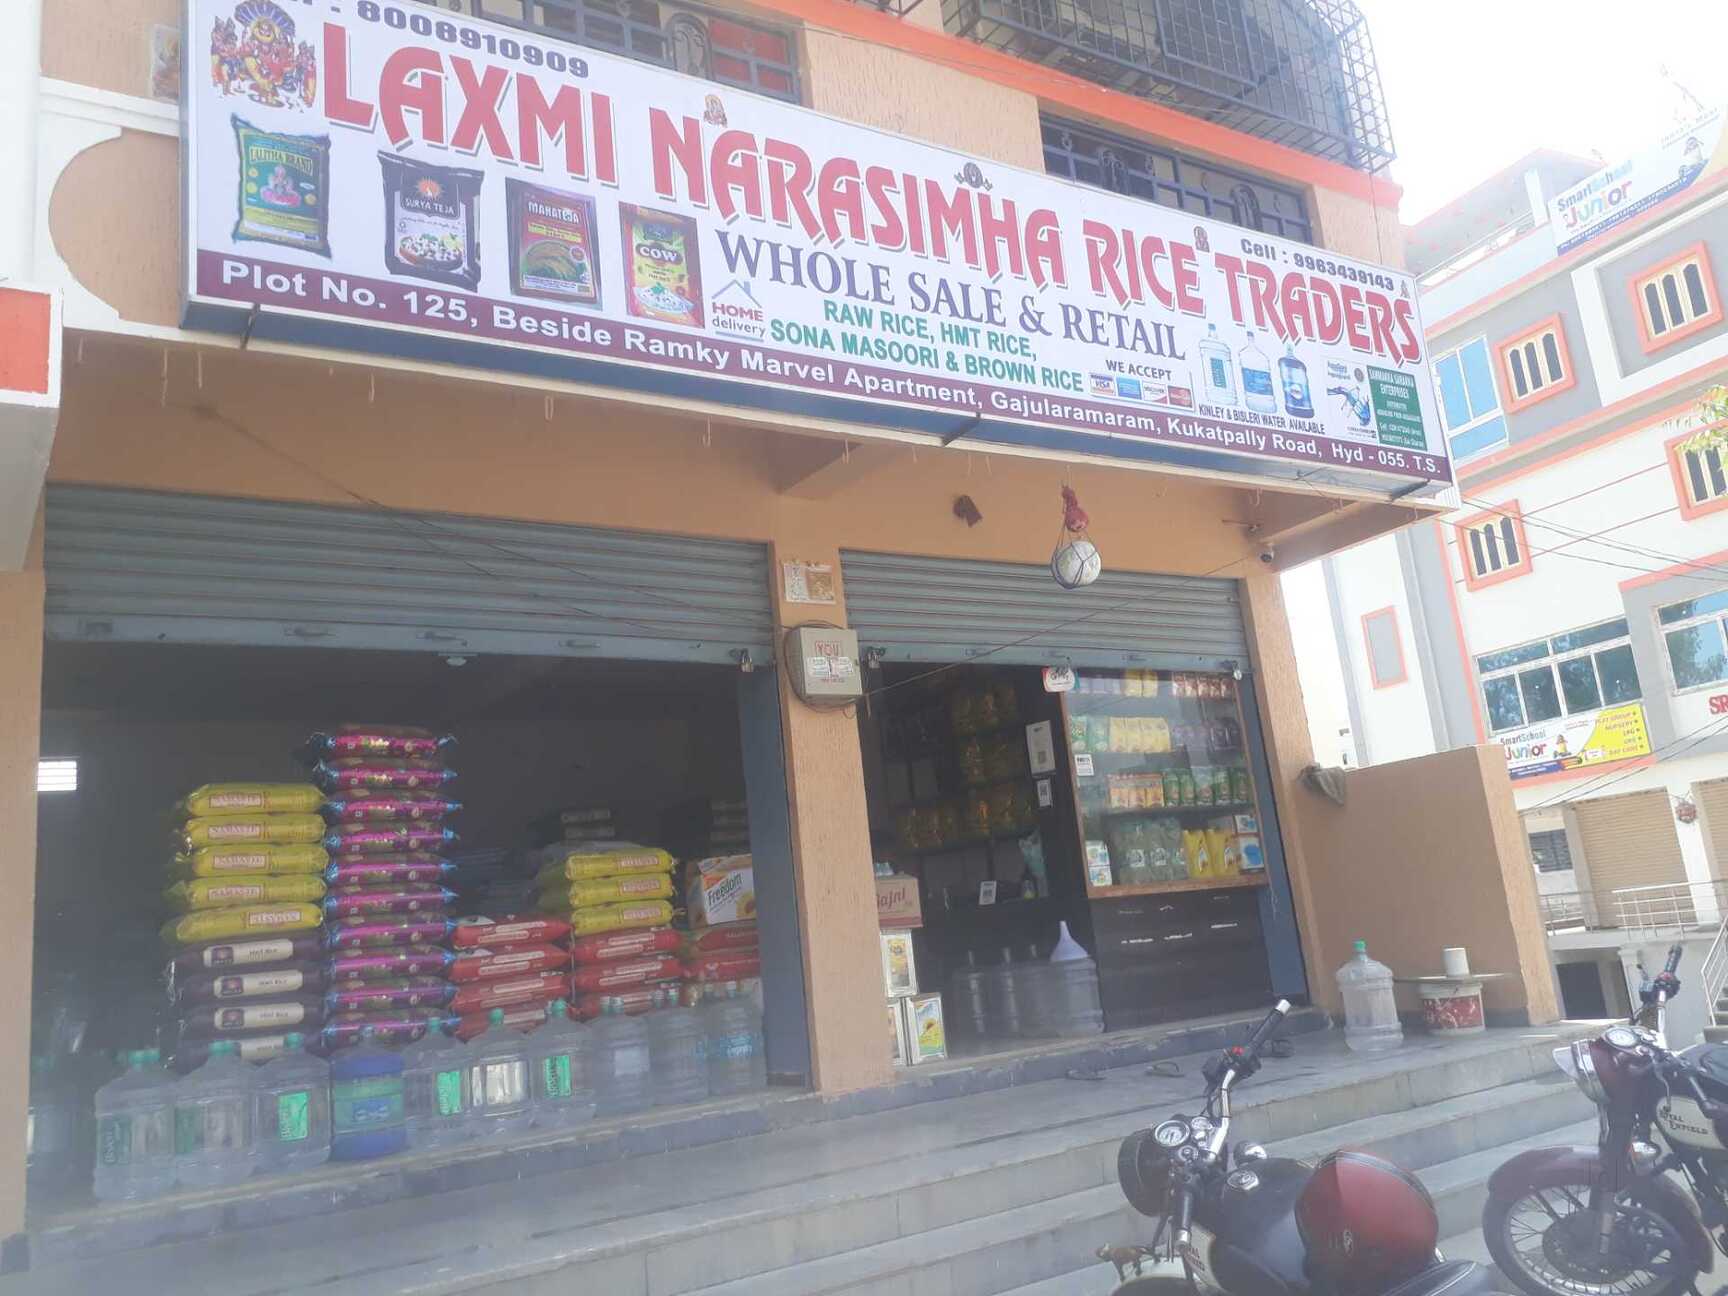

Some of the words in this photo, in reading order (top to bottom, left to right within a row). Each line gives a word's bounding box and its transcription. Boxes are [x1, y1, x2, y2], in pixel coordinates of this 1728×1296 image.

[357, 0, 589, 78] 8008910909
[322, 22, 619, 187] LAXMI
[649, 108, 1068, 292] NARASIMHA
[1083, 219, 1205, 317] RICE
[1214, 254, 1422, 367] TRADERS
[405, 198, 431, 211] SURYA
[433, 202, 455, 215] TEJA
[639, 246, 678, 263] COW
[1241, 238, 1276, 261] Cell
[1293, 252, 1394, 291] 9963439143
[712, 302, 764, 322] HOME
[715, 229, 895, 305] WHOLE
[909, 272, 1006, 328] SALE
[1019, 295, 1052, 337] &
[1058, 302, 1186, 361] RETAIL
[712, 317, 766, 338] delivery
[823, 301, 874, 330] RAW
[881, 313, 935, 344] RICE,
[940, 321, 981, 350] HMT
[987, 331, 1037, 361] RICE,
[222, 261, 308, 296] Plot
[321, 277, 385, 310] No.
[404, 290, 478, 329] 125,
[493, 305, 612, 347] Beside
[624, 328, 729, 371] Ramky
[741, 351, 834, 384] Marvel
[845, 366, 983, 410] Apartment,
[991, 393, 1161, 435] Gajularamaram,
[1167, 418, 1267, 452] Kukatpally
[1272, 435, 1323, 458] Road,
[1331, 443, 1364, 464] Hyd
[1412, 455, 1442, 474] T.S.
[771, 320, 835, 352] SONA
[842, 332, 939, 369] MASOORI
[945, 351, 959, 372] &
[965, 354, 1037, 385] BROWN
[1041, 366, 1084, 392] RICE
[1105, 359, 1125, 374] WE
[1128, 363, 1173, 381] ACCEPT
[1199, 404, 1225, 419] KINLEY
[1233, 409, 1261, 425] BISLERI
[1261, 414, 1287, 430] WATER
[1289, 418, 1325, 435] AVAILABLE
[1504, 743, 1547, 761] Junior
[706, 871, 743, 907] Freedom
